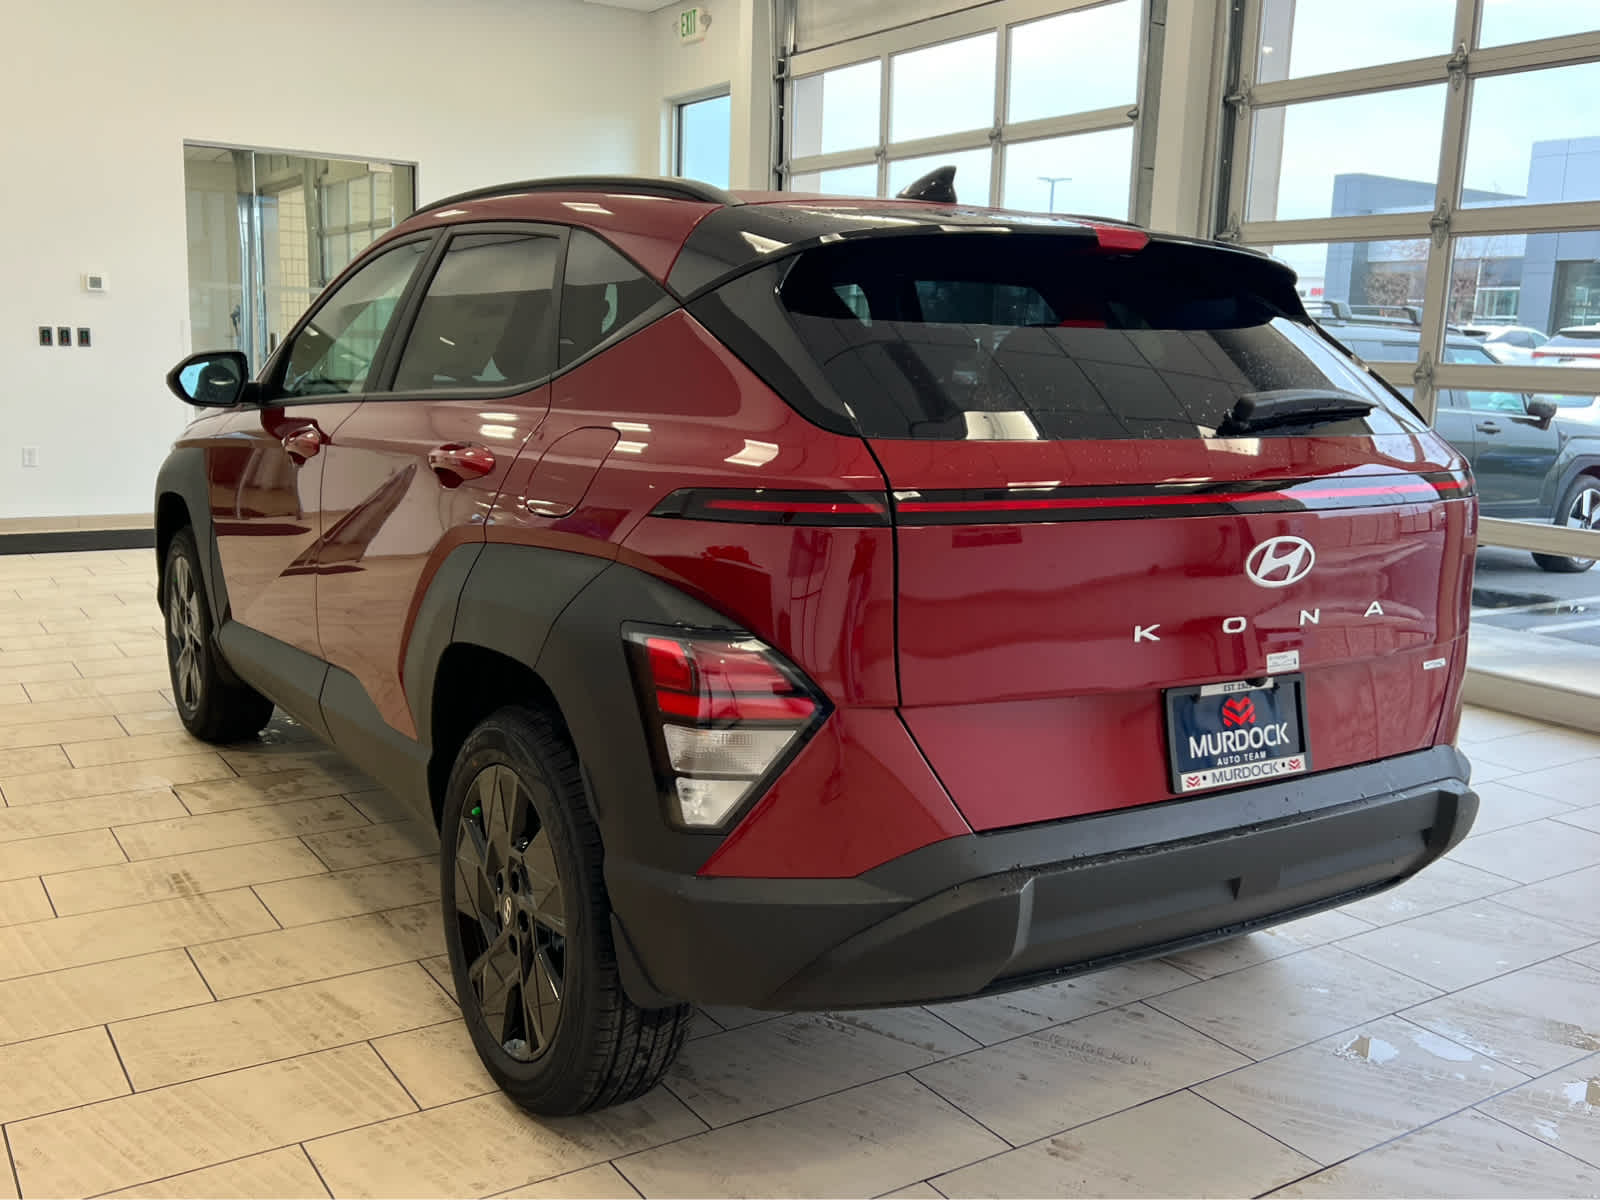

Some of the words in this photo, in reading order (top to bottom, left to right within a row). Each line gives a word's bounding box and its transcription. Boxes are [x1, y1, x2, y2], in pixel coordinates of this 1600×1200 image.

[681, 9, 697, 37] EXIT
[1134, 601, 1384, 642] KONA
[1189, 722, 1290, 758] MURDOCK
[1212, 761, 1280, 783] MURDOCK
[1217, 755, 1241, 766] AUTO
[1244, 751, 1267, 761] TEAM
